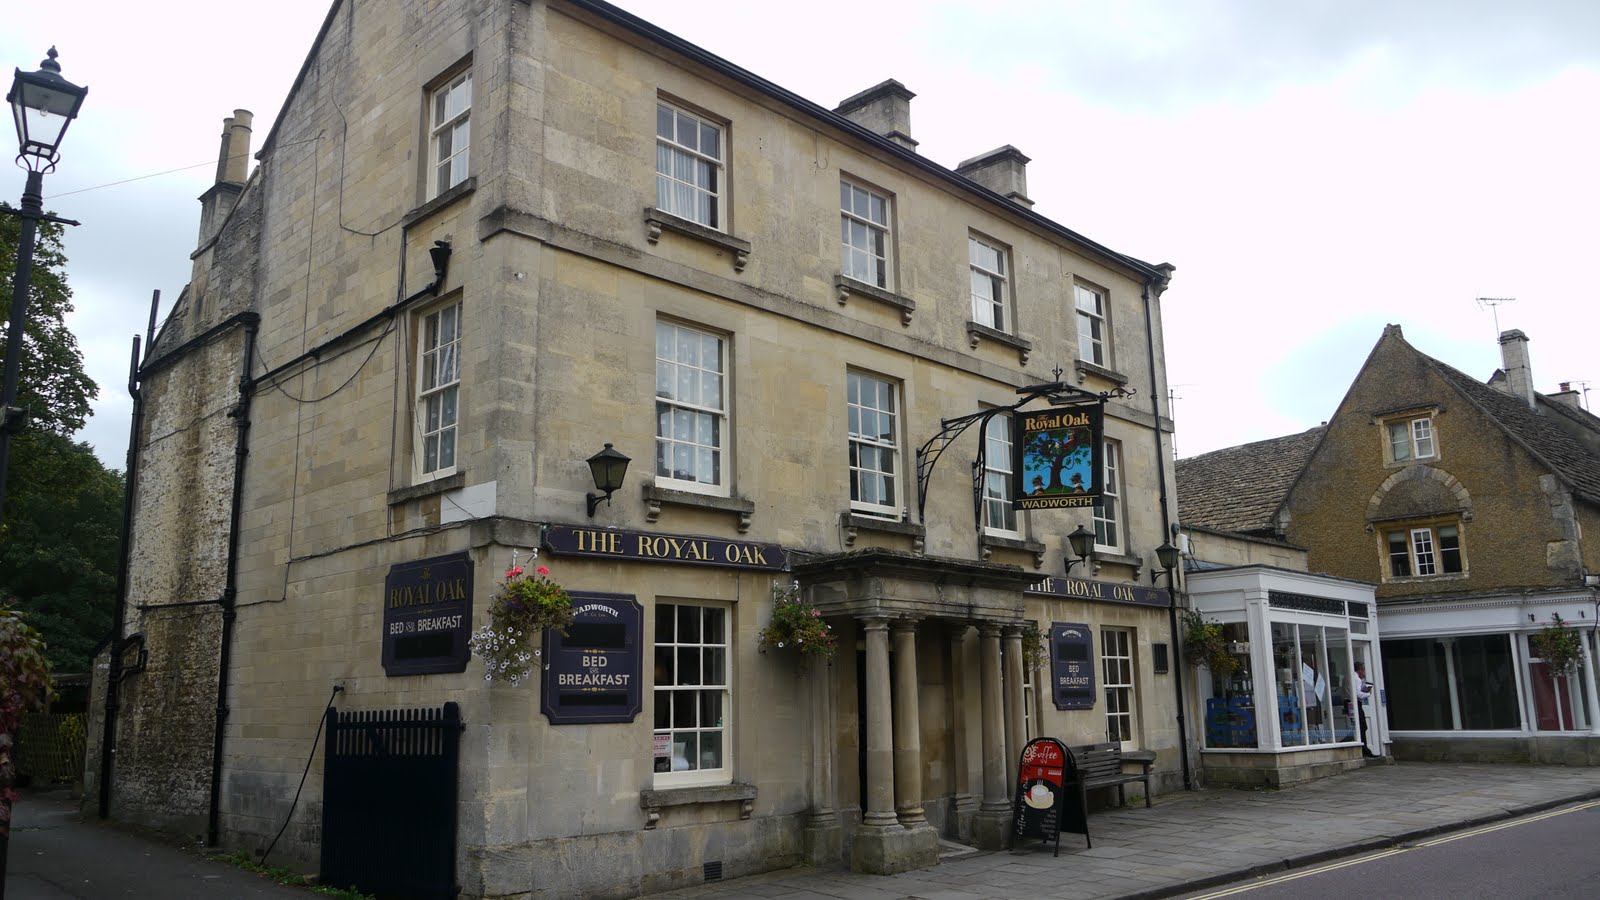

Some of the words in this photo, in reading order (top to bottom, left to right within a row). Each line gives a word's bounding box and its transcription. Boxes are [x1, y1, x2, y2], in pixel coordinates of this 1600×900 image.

[1025, 415, 1060, 431] Royal
[1062, 412, 1090, 427] Oak
[1022, 498, 1093, 508] WADWORTH
[573, 529, 624, 554] THE
[638, 535, 715, 561] ROYAL
[725, 543, 768, 565] OAK
[390, 583, 433, 609] ROYAL
[436, 578, 465, 602] OAK
[1067, 580, 1105, 599] ROYAL
[1113, 585, 1136, 602] OAK
[390, 621, 404, 635] BED
[417, 615, 462, 632] BREAKFAST
[582, 656, 608, 667] BED
[1068, 664, 1080, 673] BED
[559, 674, 629, 685] BREAKFAST
[1060, 677, 1089, 685] BREAKFAST
[1033, 744, 1058, 763] Coffee
